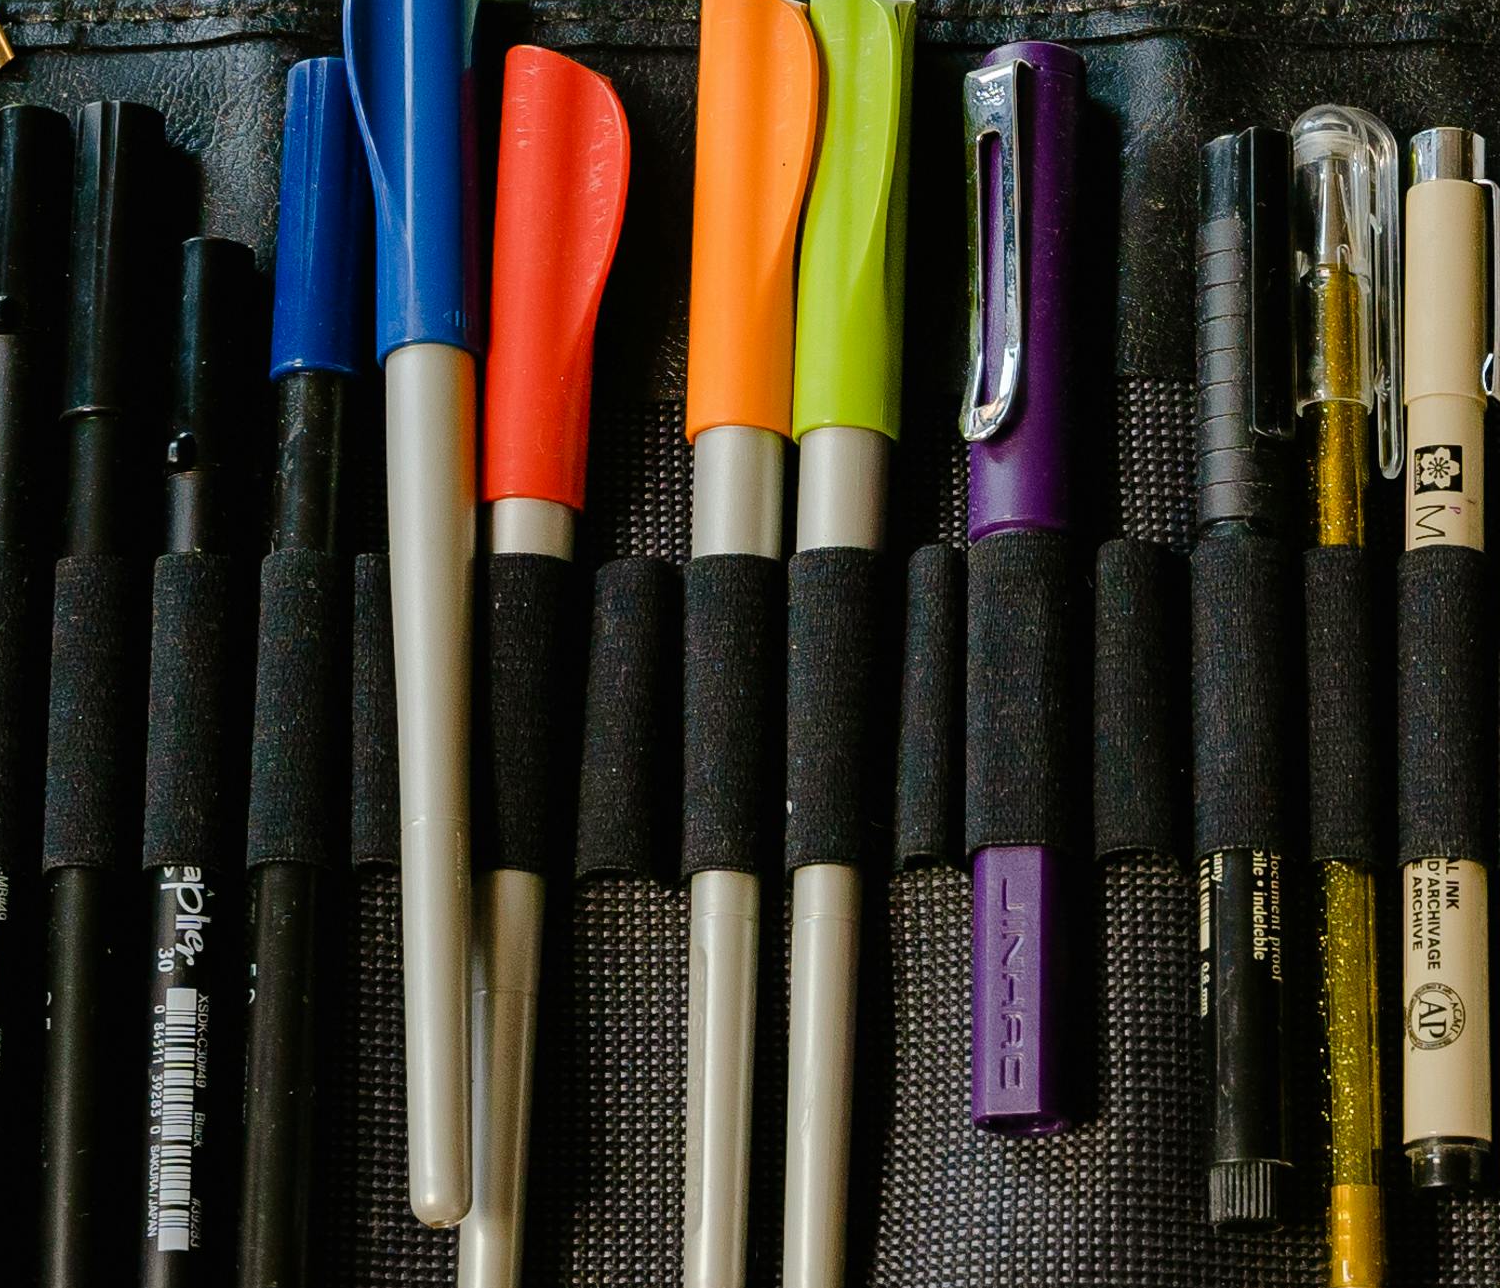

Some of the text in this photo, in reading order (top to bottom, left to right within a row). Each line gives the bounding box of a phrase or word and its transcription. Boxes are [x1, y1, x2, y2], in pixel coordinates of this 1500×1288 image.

[1412, 876, 1423, 951] ARCHIVE
[1427, 860, 1441, 970] D'ARCHIVAGE
[1445, 880, 1460, 909] INK
[1253, 891, 1268, 961] indeleble
[1268, 936, 1283, 983] proof
[1418, 998, 1447, 1038] AP
[152, 1022, 165, 1064] 84511
[151, 1074, 164, 1117] 39283
[190, 993, 210, 1248] XSDK-C30#49 Black #39283
